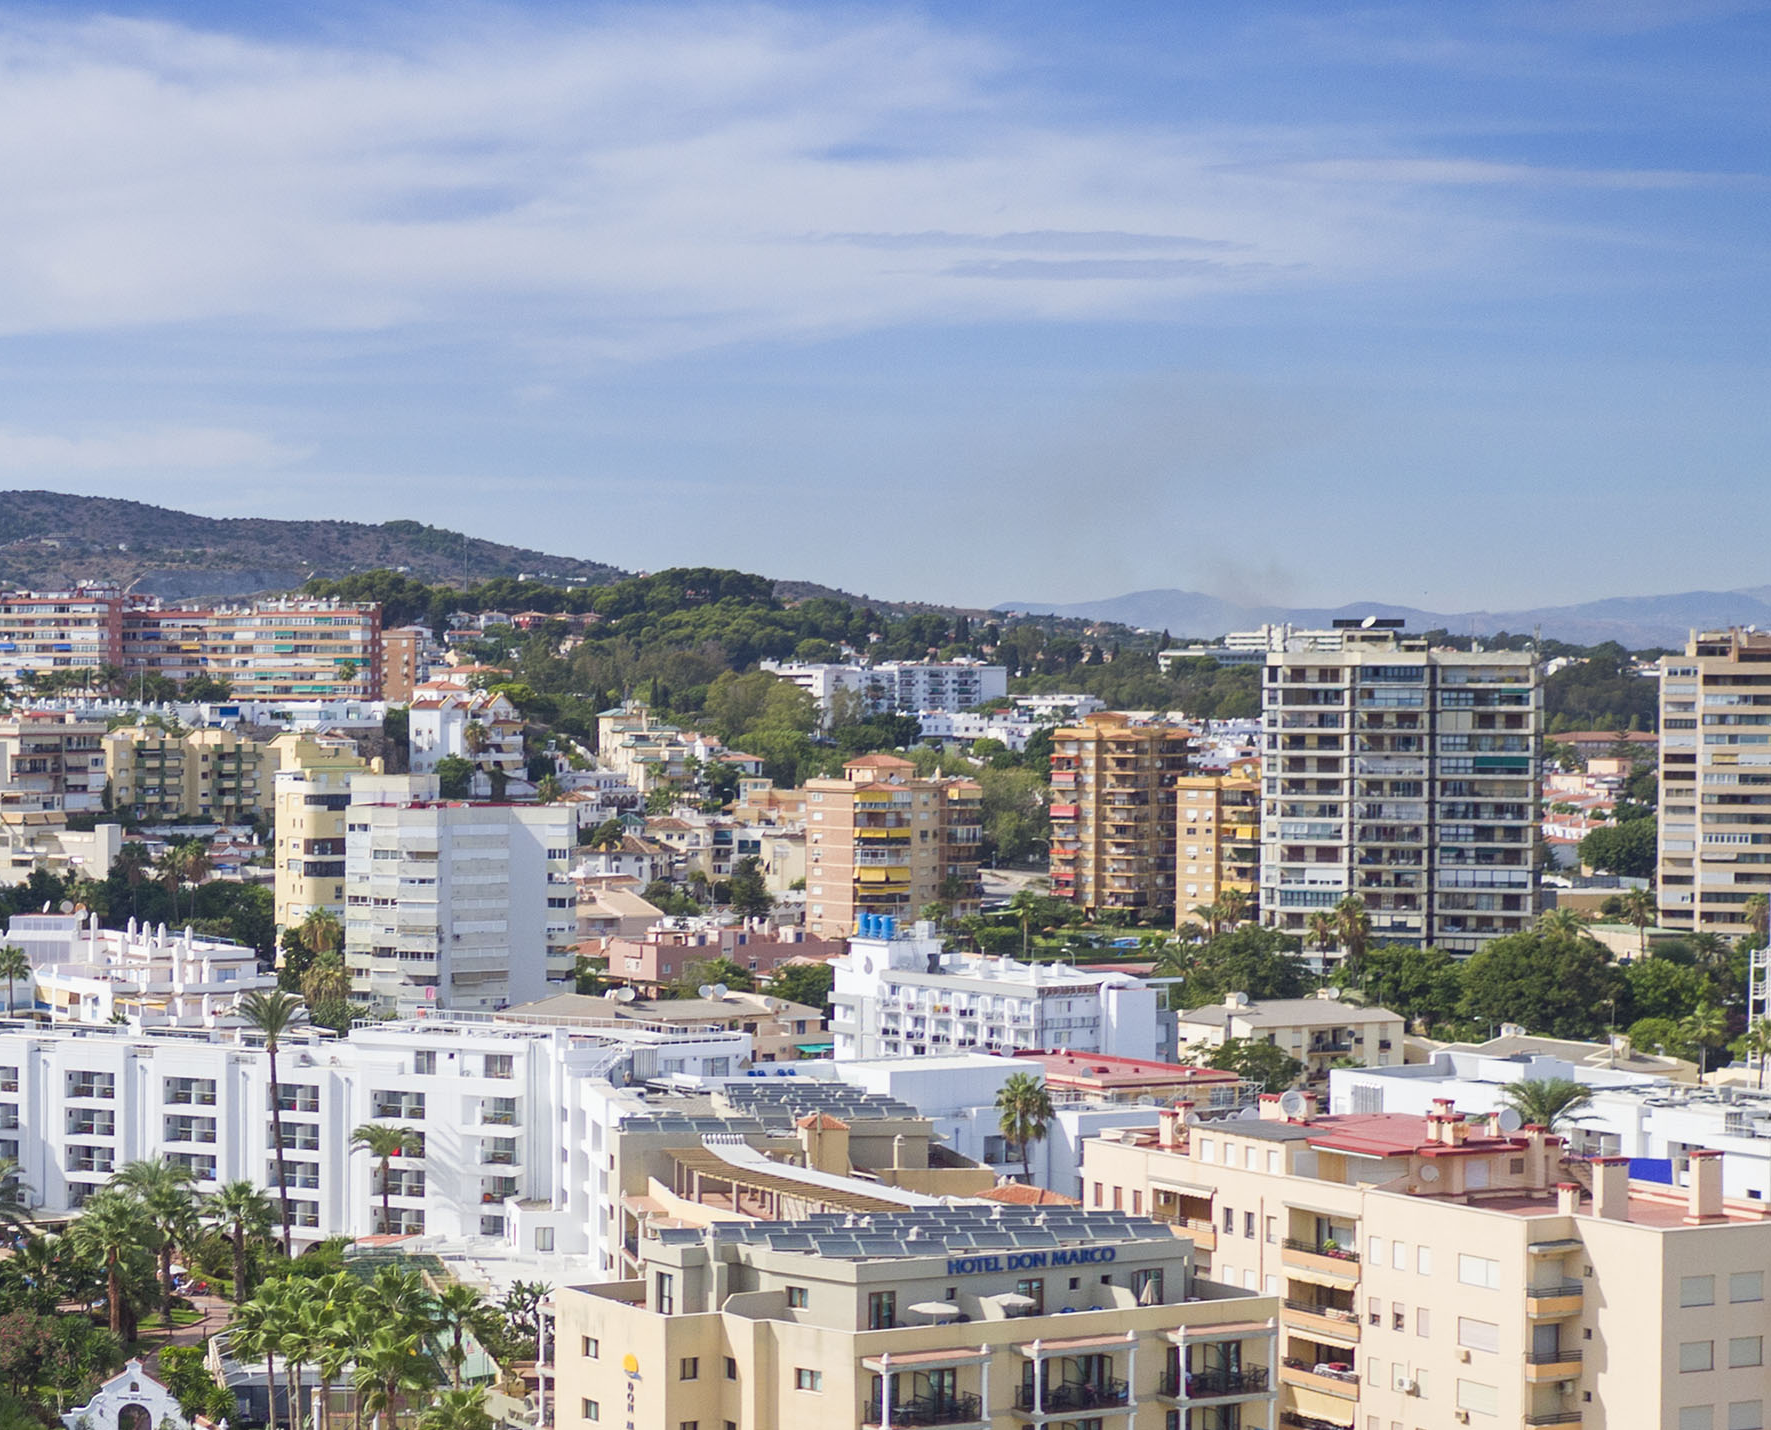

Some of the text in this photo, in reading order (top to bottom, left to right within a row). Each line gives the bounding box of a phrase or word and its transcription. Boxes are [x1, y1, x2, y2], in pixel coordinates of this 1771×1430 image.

[947, 1246, 1116, 1275] HOTEL DON MARCO
